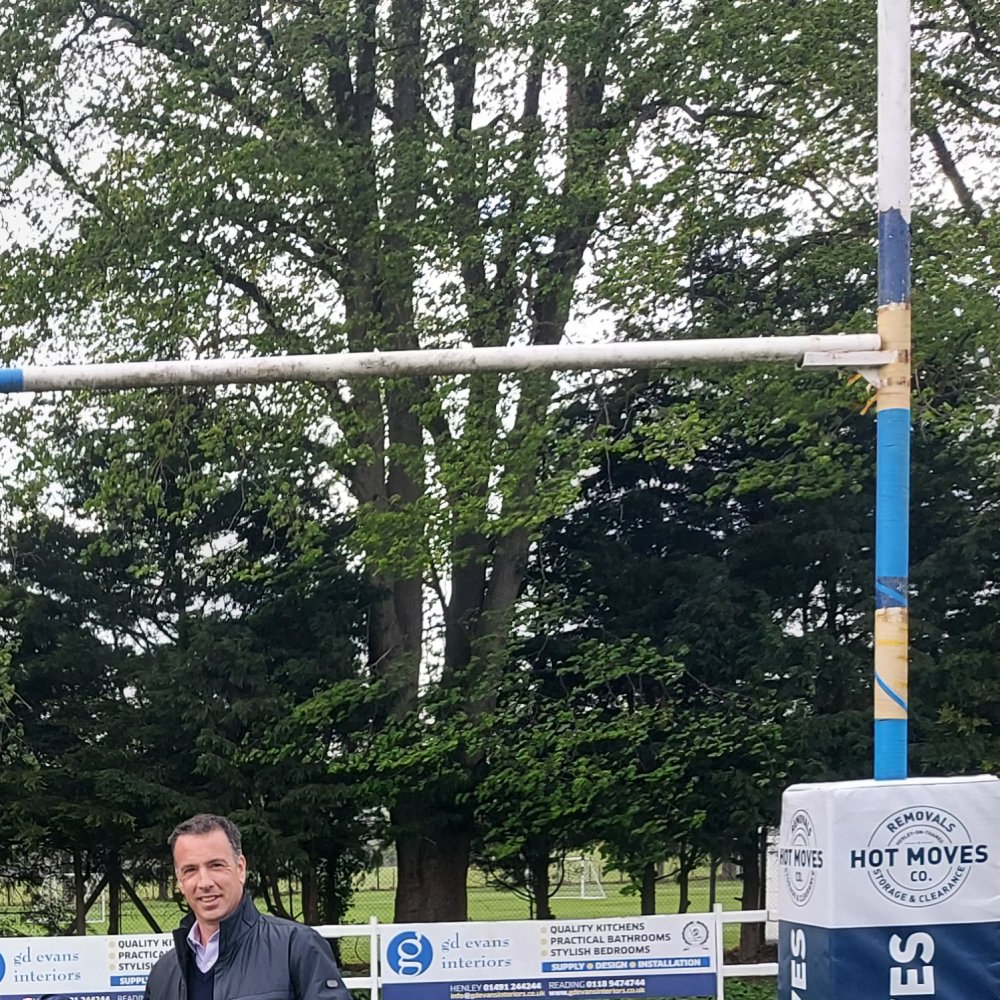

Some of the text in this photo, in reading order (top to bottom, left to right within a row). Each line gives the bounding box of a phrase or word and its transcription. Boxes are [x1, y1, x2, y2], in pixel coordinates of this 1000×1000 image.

[887, 811, 956, 833] REMOVALS
[779, 848, 823, 868] HOT MOVES
[851, 844, 989, 868] HOT MOVES
[910, 870, 932, 882] CO.
[873, 866, 965, 903] STORAGE & CLEARANCE
[550, 923, 645, 934] QUALITY KITCHENS
[118, 939, 159, 949] QUALITY
[465, 937, 511, 949] evans
[550, 934, 671, 945] PRACTICAL BATHROOMS
[14, 947, 80, 965] gd evans
[118, 951, 167, 960] PRACTICA
[550, 946, 651, 957] STYLISH BEDROOMS
[441, 956, 512, 970] interiors
[551, 959, 701, 971] SUPPLY DESIGN INSTALLATION
[14, 969, 82, 983] interiors
[120, 976, 148, 985] SUPPL
[450, 984, 482, 992] HENLEY
[549, 981, 585, 989] READING
[586, 980, 608, 988] 0118
